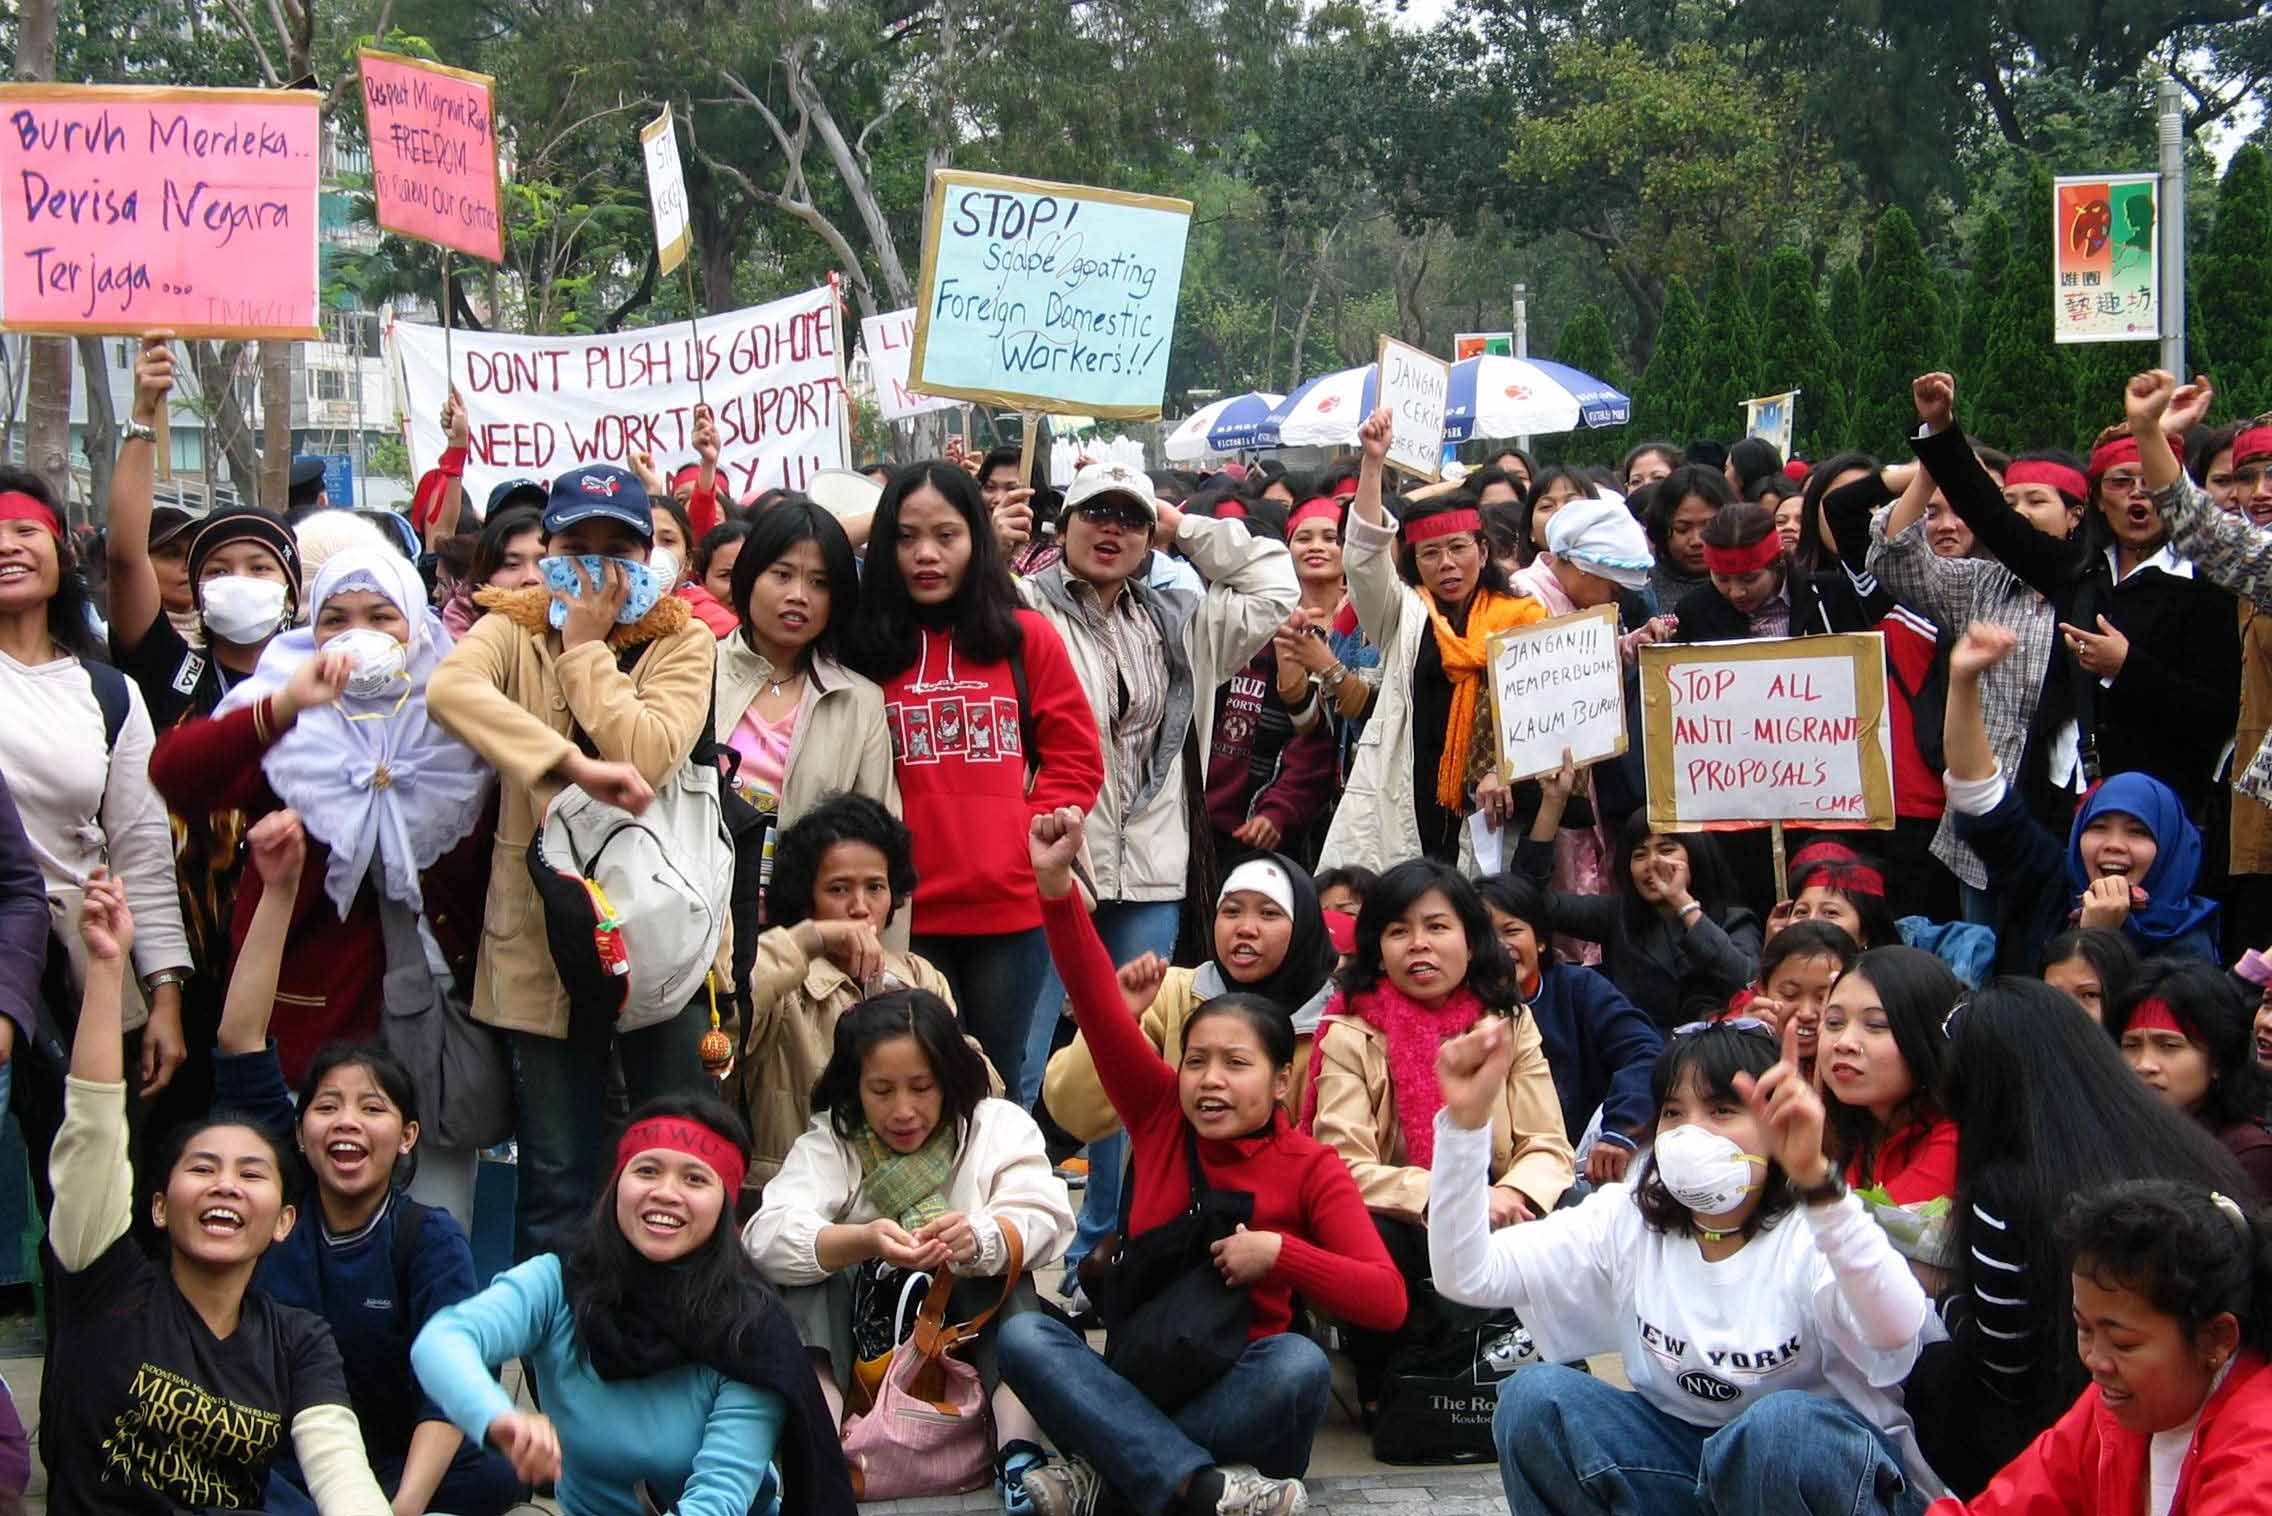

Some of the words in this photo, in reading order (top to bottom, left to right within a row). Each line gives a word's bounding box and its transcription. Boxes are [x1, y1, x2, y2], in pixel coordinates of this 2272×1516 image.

[10, 109, 125, 155] Buruh
[390, 123, 466, 175] FREEDOM
[161, 178, 289, 249] Negara
[953, 191, 1080, 242] STOP!
[936, 278, 1026, 338] Foreign
[1045, 291, 1153, 338] Domestic
[467, 350, 569, 394] DON'T
[587, 340, 671, 390] PUSH
[685, 334, 720, 382] US
[1391, 357, 1442, 398] JANGAN
[467, 421, 555, 468] NEED
[565, 408, 668, 466] WORK
[720, 376, 841, 447] SUPORT
[181, 656, 203, 688] FILA
[1504, 659, 1617, 702] MEMPERBUDAK
[1665, 663, 1736, 706] STOP
[1767, 673, 1823, 702] ALL
[1508, 715, 1565, 749] KAUM
[1707, 1335, 1801, 1369] YORK
[128, 1369, 282, 1449] MIGRANTS
[1430, 1395, 1467, 1411] The
[1686, 1377, 1734, 1400] NYC
[147, 1401, 254, 1464] RIGHTS
